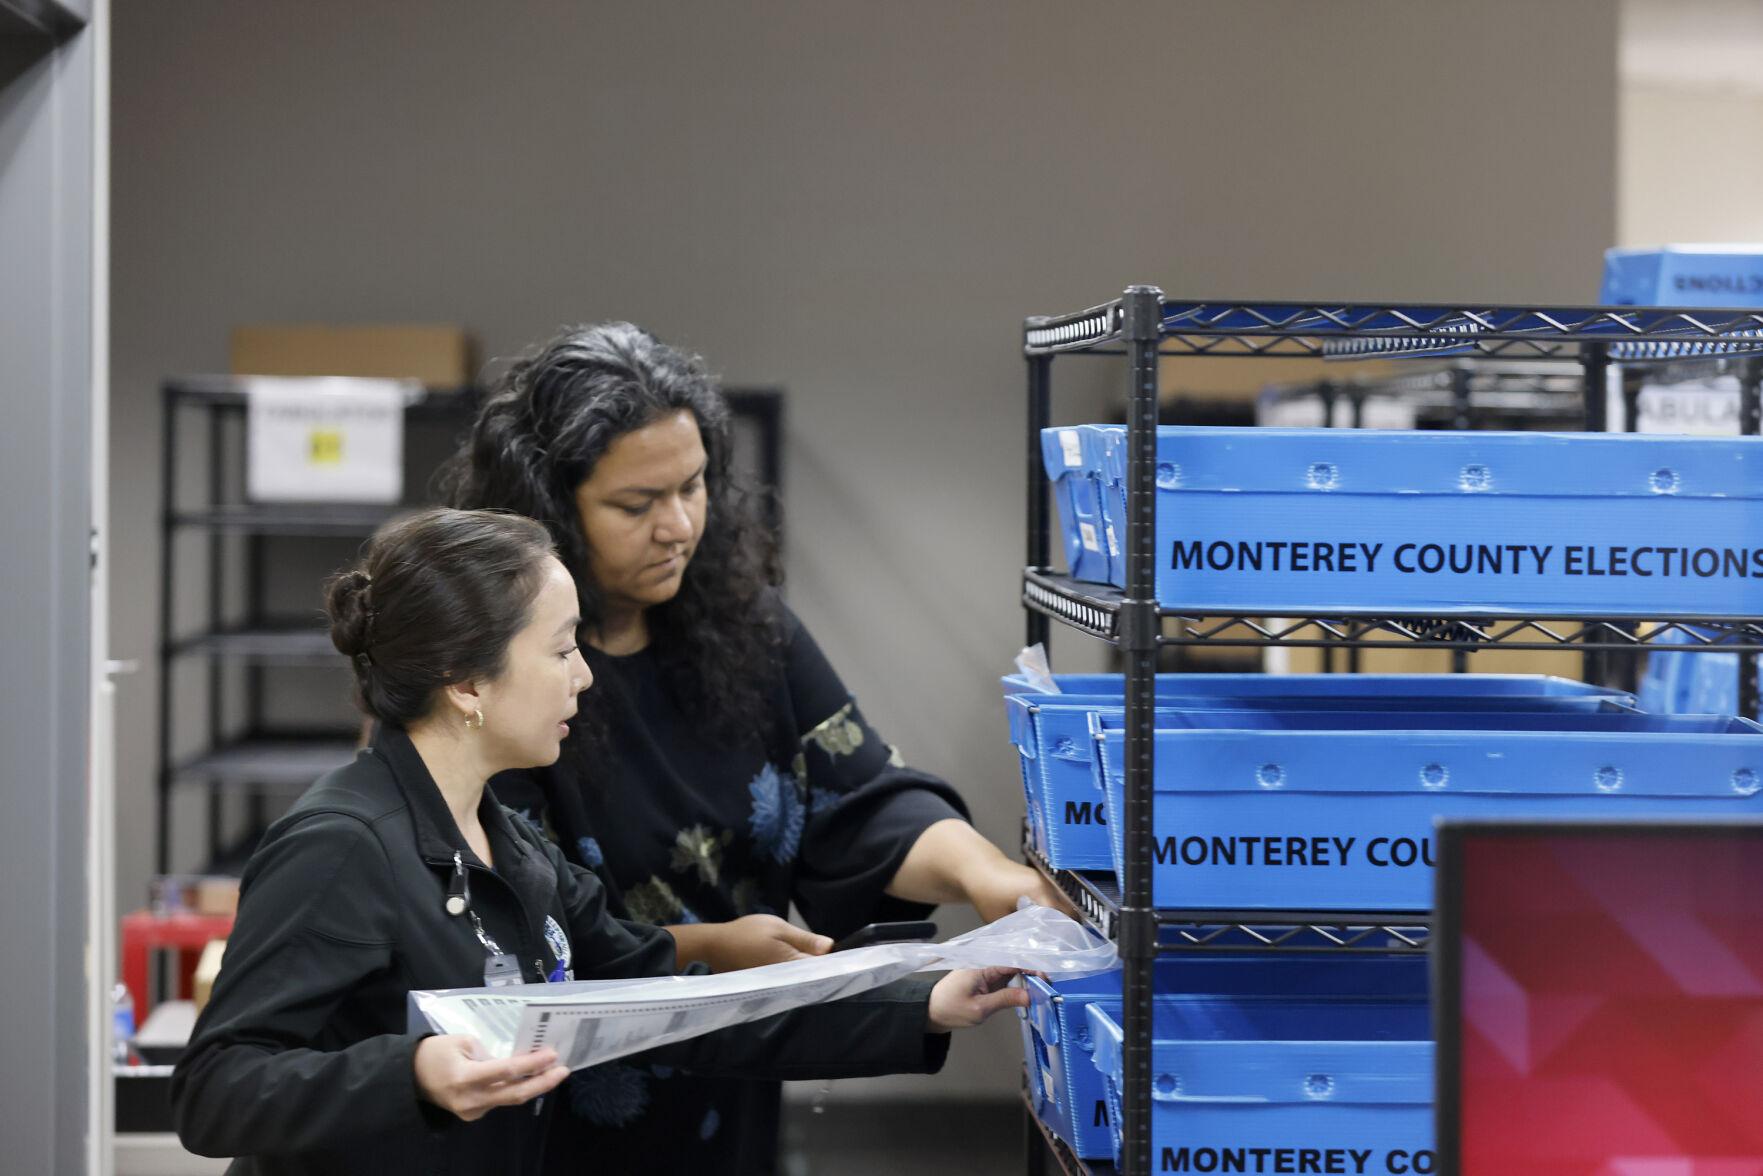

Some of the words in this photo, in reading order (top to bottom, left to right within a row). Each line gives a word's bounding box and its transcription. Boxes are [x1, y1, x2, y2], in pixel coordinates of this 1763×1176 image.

[1171, 540, 1383, 572] MONTEREY
[1393, 543, 1554, 574] COUNTY
[1565, 546, 1763, 578] ELECTIONS
[1152, 836, 1356, 866] MONTEREY
[1161, 1147, 1371, 1174] MONTEREY
